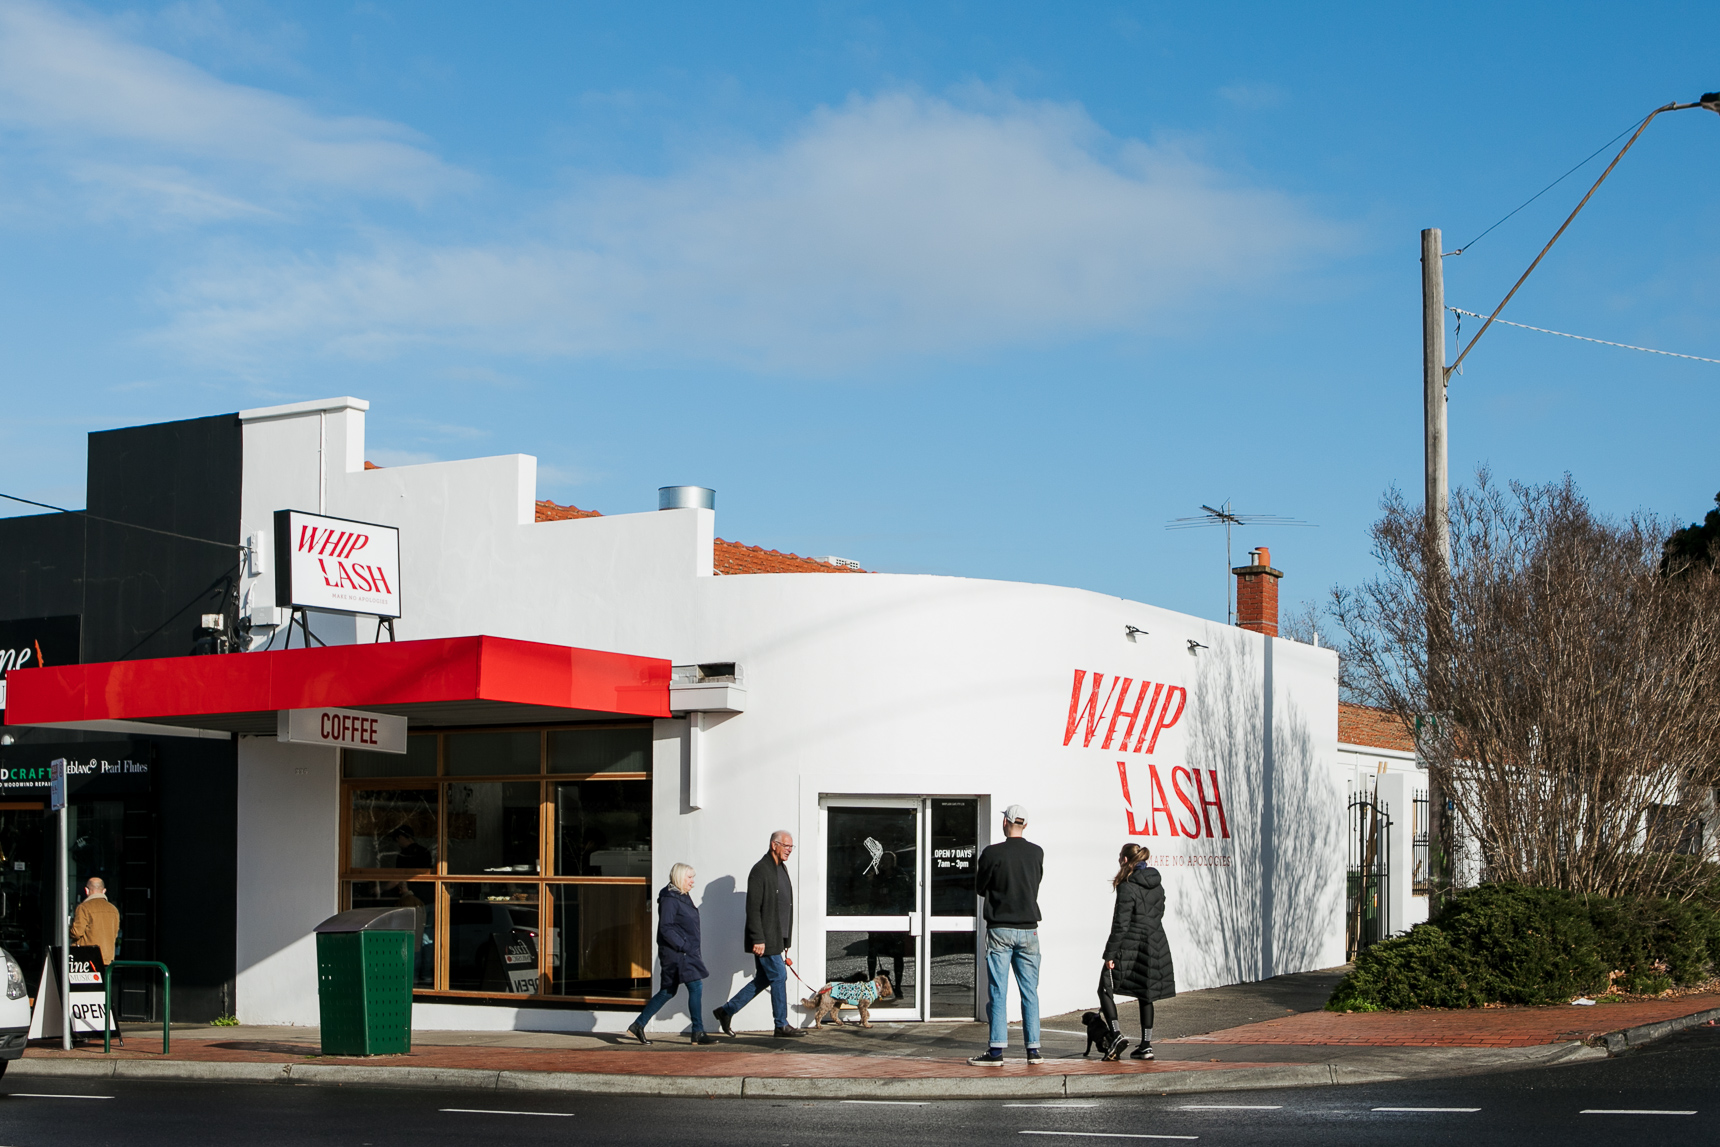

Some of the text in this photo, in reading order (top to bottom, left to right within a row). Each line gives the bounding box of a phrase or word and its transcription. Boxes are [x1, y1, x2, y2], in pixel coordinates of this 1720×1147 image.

[298, 525, 369, 559] WHIP
[318, 558, 392, 594] LASH
[358, 596, 388, 605] APOLOGIES
[1063, 669, 1187, 755] WHIP
[321, 712, 378, 745] COFFEE
[101, 760, 148, 774] Pearl Flutes
[1116, 761, 1231, 839] LASH
[934, 849, 972, 858] OPEN 7 DAYS
[937, 859, 950, 868] 7am
[956, 859, 969, 870] 3pm
[1147, 855, 1231, 867] MAKE NO APOLOGIES
[70, 974, 93, 982] MUSIC
